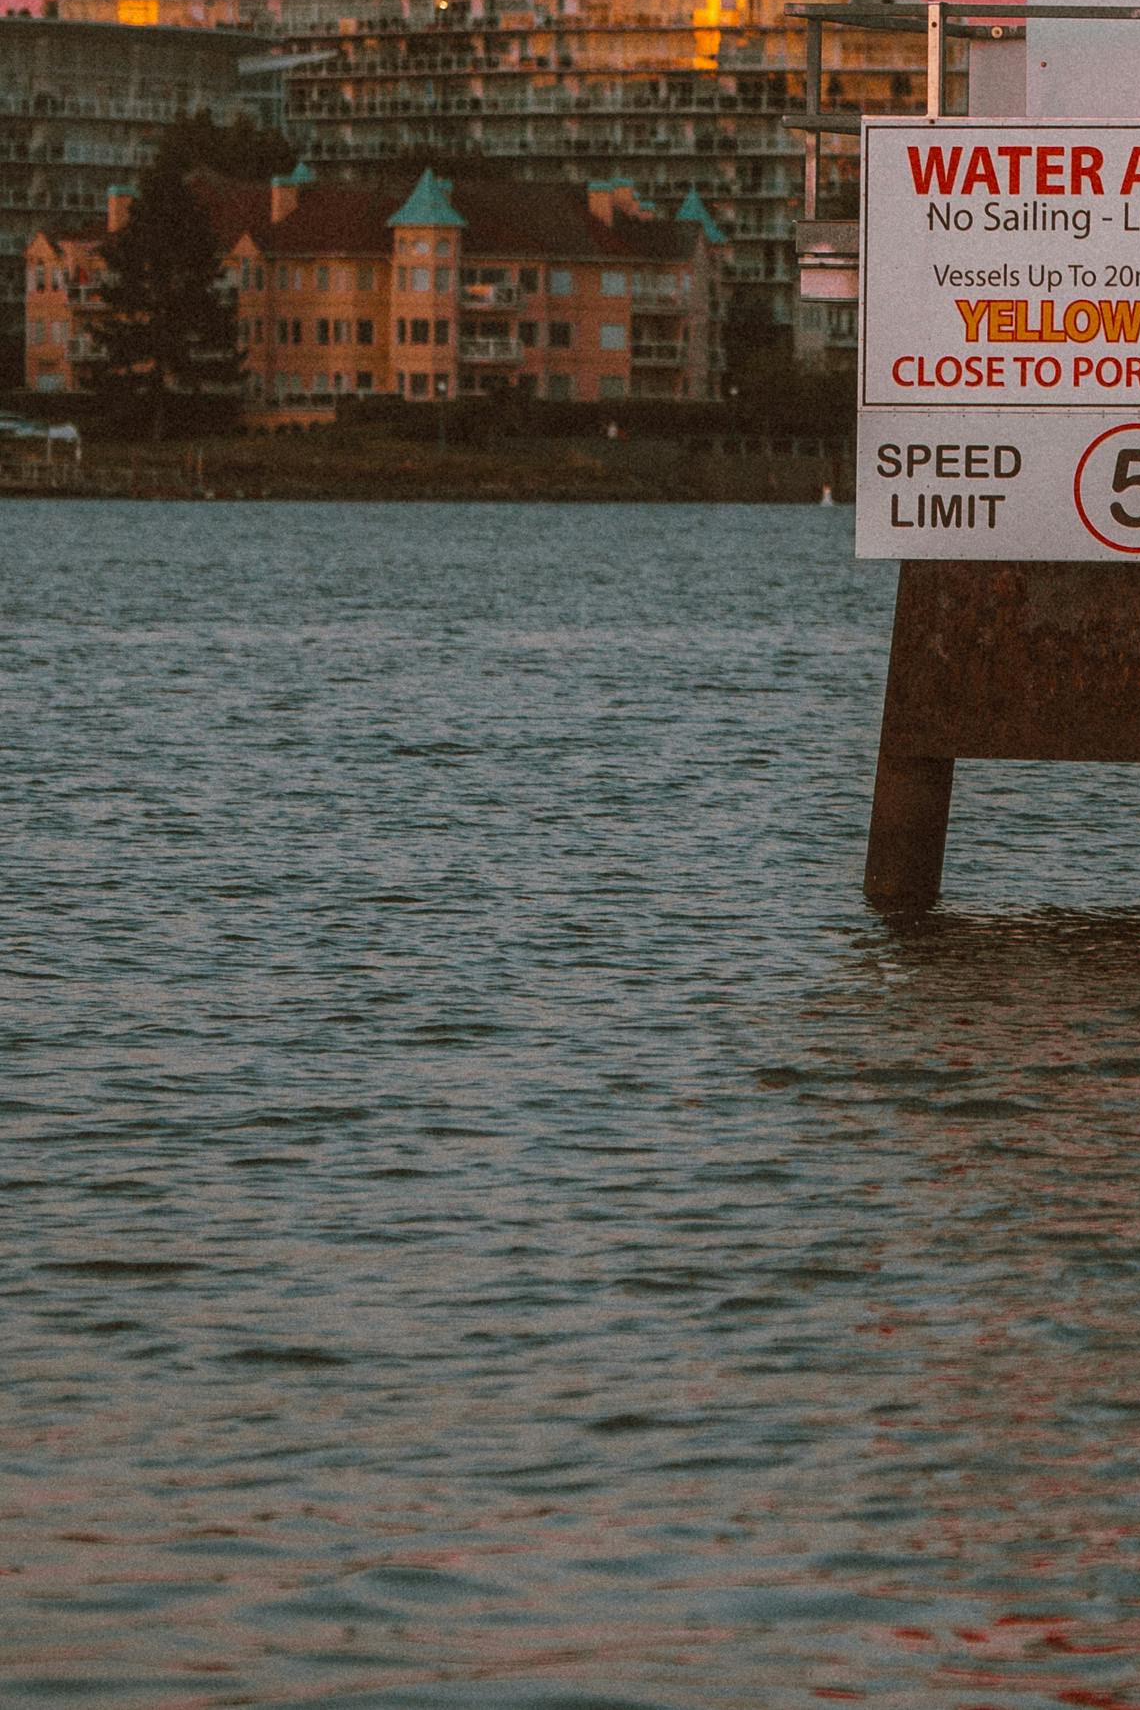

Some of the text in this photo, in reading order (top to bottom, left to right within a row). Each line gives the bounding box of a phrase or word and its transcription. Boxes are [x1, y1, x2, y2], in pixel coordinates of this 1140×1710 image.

[907, 146, 1104, 195] WATER
[928, 202, 973, 231] No
[984, 202, 1091, 238] Sailing
[933, 264, 1020, 287] Vessels
[1028, 265, 1062, 292] Up
[1068, 265, 1096, 287] To
[892, 356, 1004, 388] CLOSE
[1014, 357, 1061, 387] TO
[877, 444, 1021, 479] SPEED
[891, 495, 1005, 529] LIMIT
